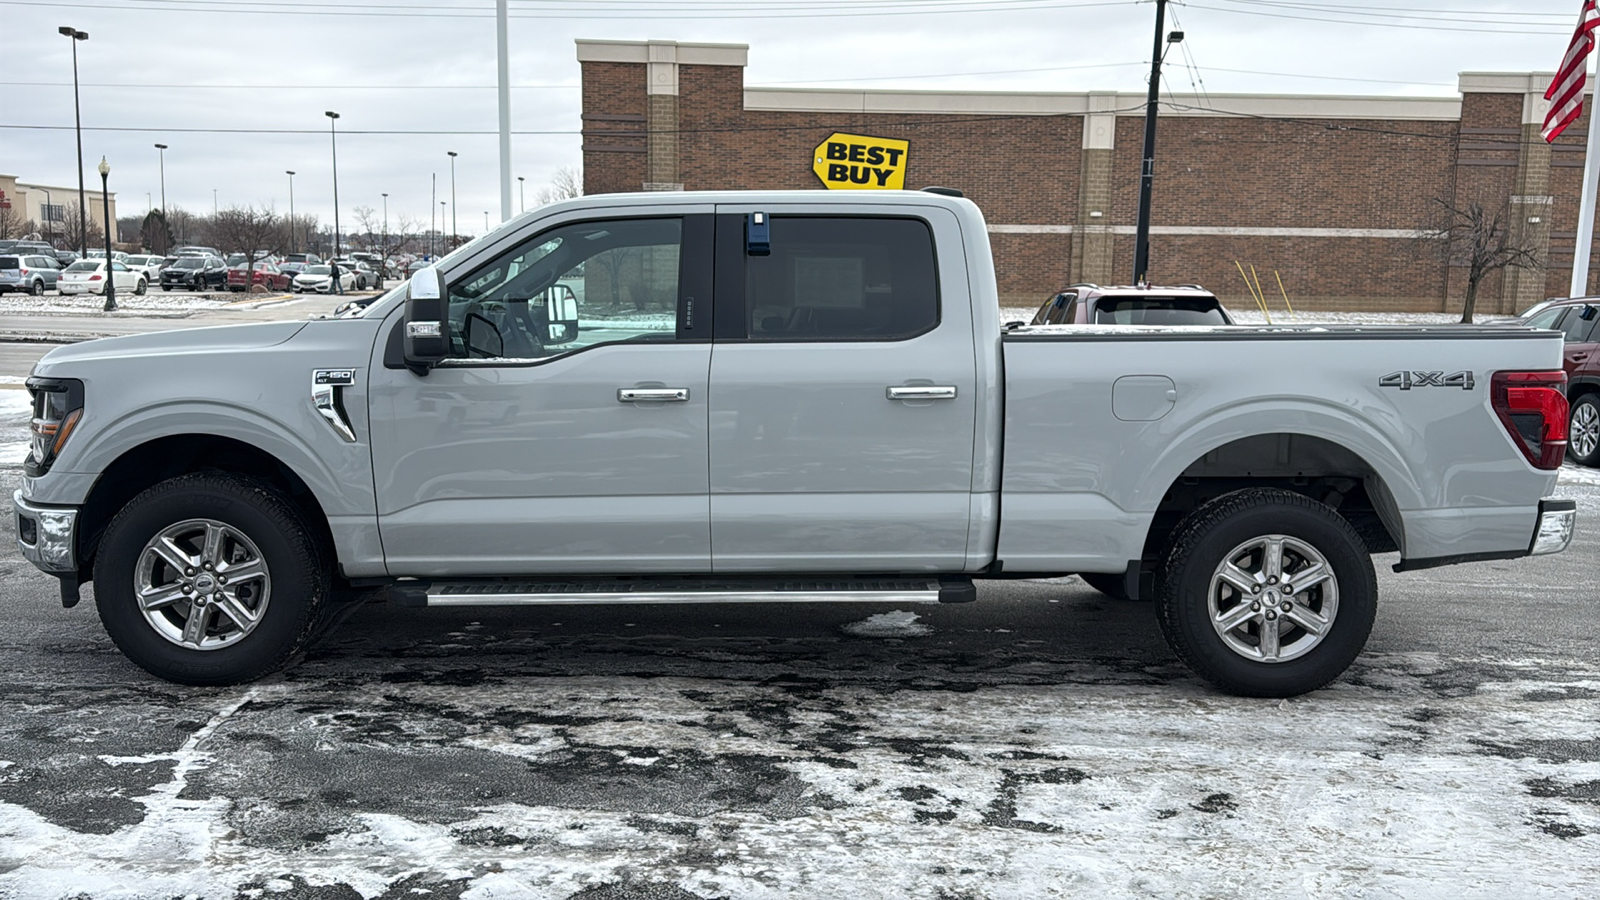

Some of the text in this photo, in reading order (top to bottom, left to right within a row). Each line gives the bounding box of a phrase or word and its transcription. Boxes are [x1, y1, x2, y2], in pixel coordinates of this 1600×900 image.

[827, 142, 904, 167] BEST
[828, 163, 895, 187] BUY
[316, 371, 351, 379] F-150
